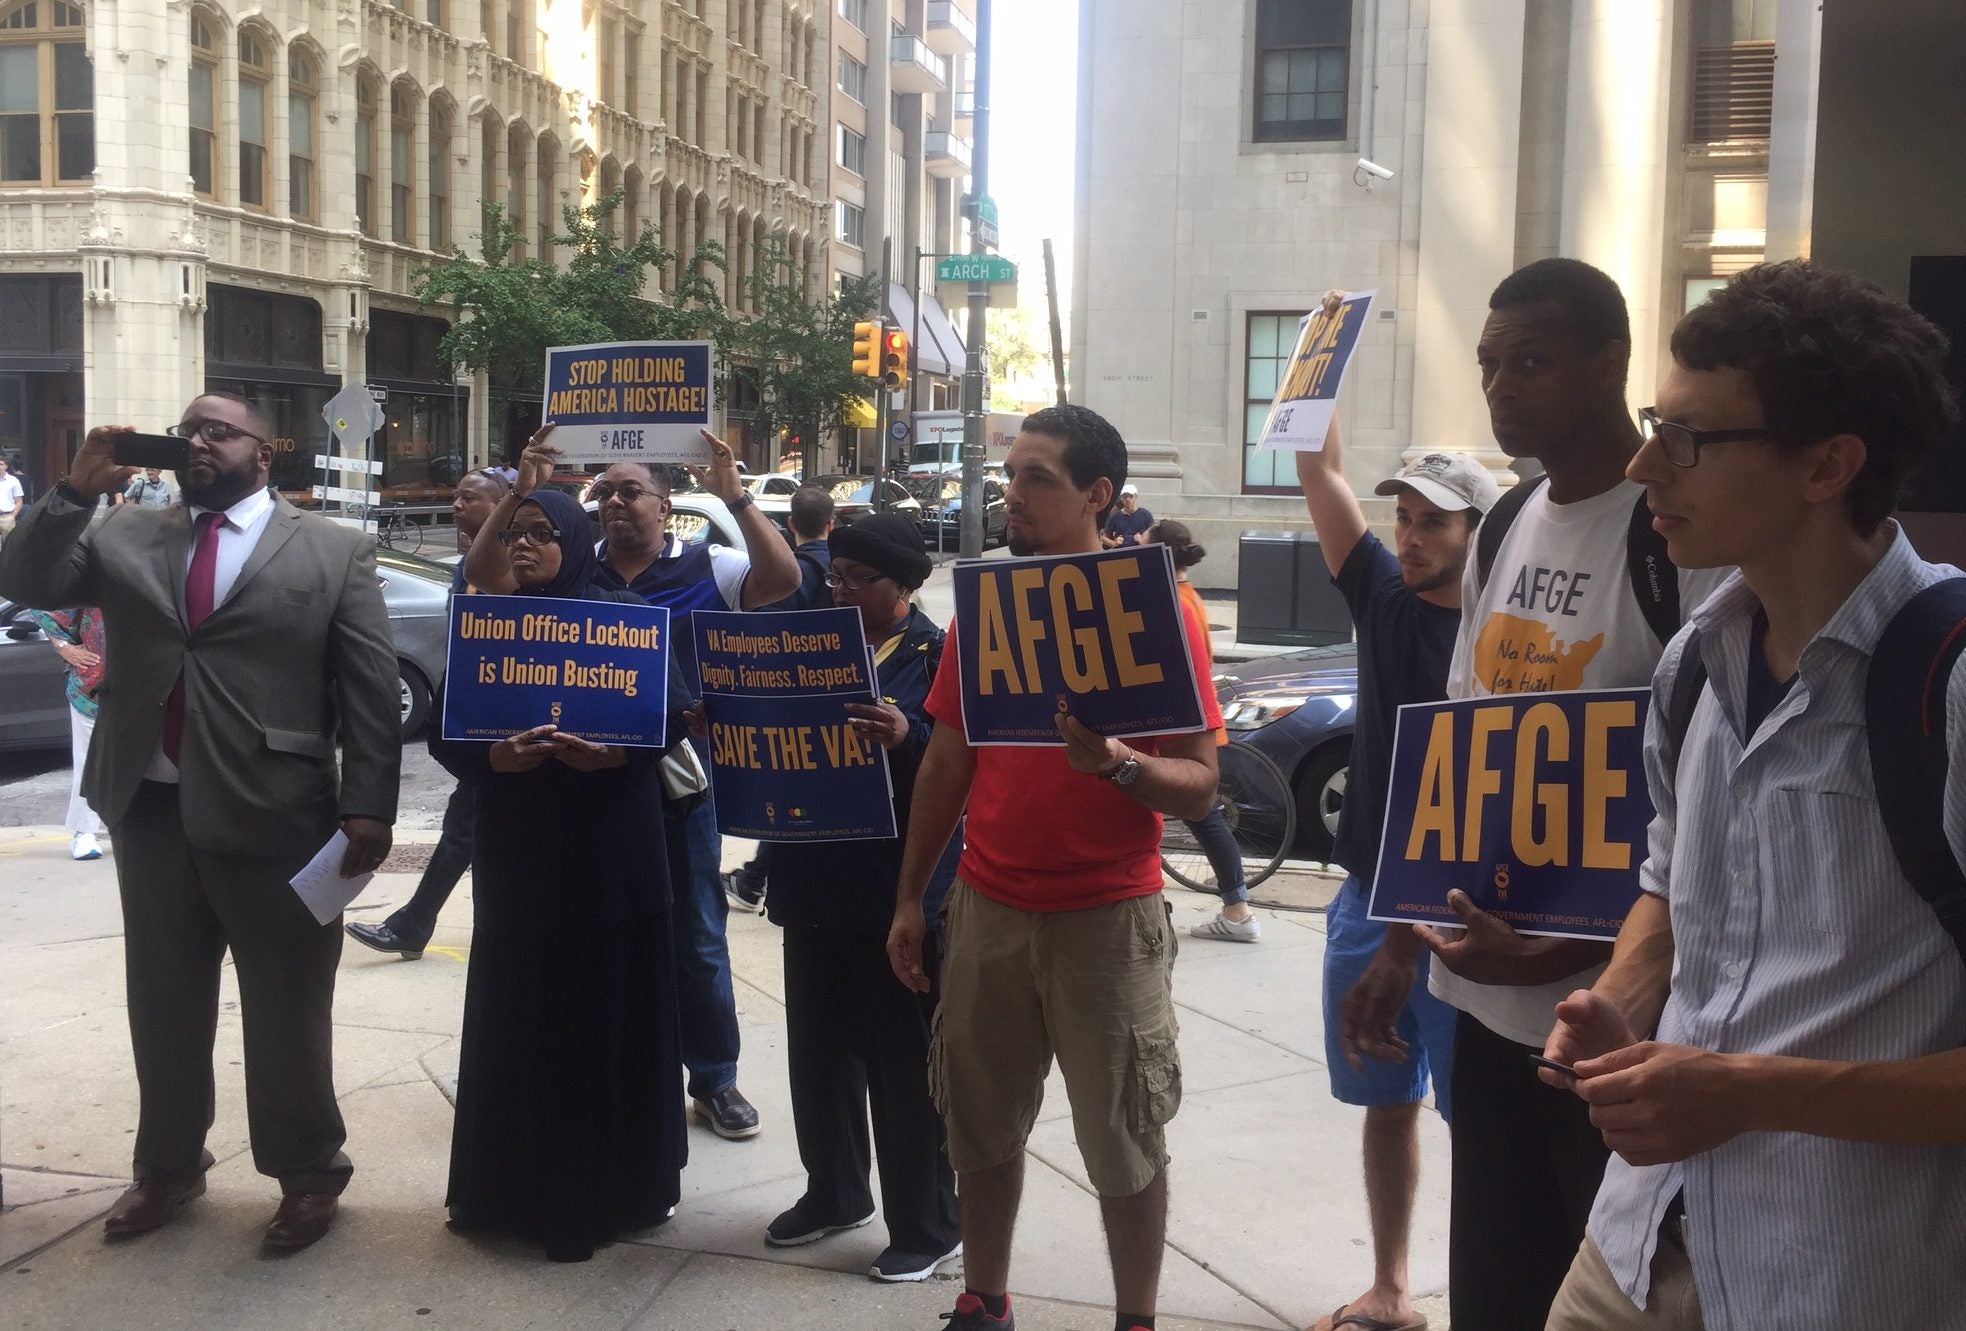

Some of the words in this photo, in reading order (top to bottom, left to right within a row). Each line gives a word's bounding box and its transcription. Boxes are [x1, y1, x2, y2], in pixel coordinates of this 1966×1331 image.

[952, 264, 989, 279] ARCH
[1000, 268, 1011, 279] ST
[568, 359, 608, 386] STOP
[612, 357, 685, 384] HOLDING
[549, 387, 618, 416] AMERICA
[623, 386, 706, 412] HOSTAGE!
[611, 430, 644, 450] AFGE
[1506, 565, 1591, 616] AFGE
[1647, 563, 1662, 602] Columbia
[461, 612, 515, 640] Union
[522, 614, 580, 643] Office
[586, 617, 659, 649] Lockout
[979, 557, 1165, 695] AFGE
[707, 629, 720, 651] VA
[721, 630, 780, 659] Employees
[782, 630, 841, 653] Deserve
[1497, 640, 1519, 660] No
[1523, 642, 1558, 664] Room
[479, 656, 496, 684] is
[502, 657, 558, 686] Union
[563, 660, 638, 696] Busting
[701, 662, 739, 691] Dignity.
[739, 665, 796, 688] Fairness.
[798, 662, 864, 690] Respect.
[1491, 669, 1513, 695] for
[712, 722, 762, 769] SAVE
[763, 726, 817, 770] THE
[820, 724, 875, 768] VA!
[1404, 700, 1636, 869] AFGE
[1395, 903, 1430, 913] AMERICAN
